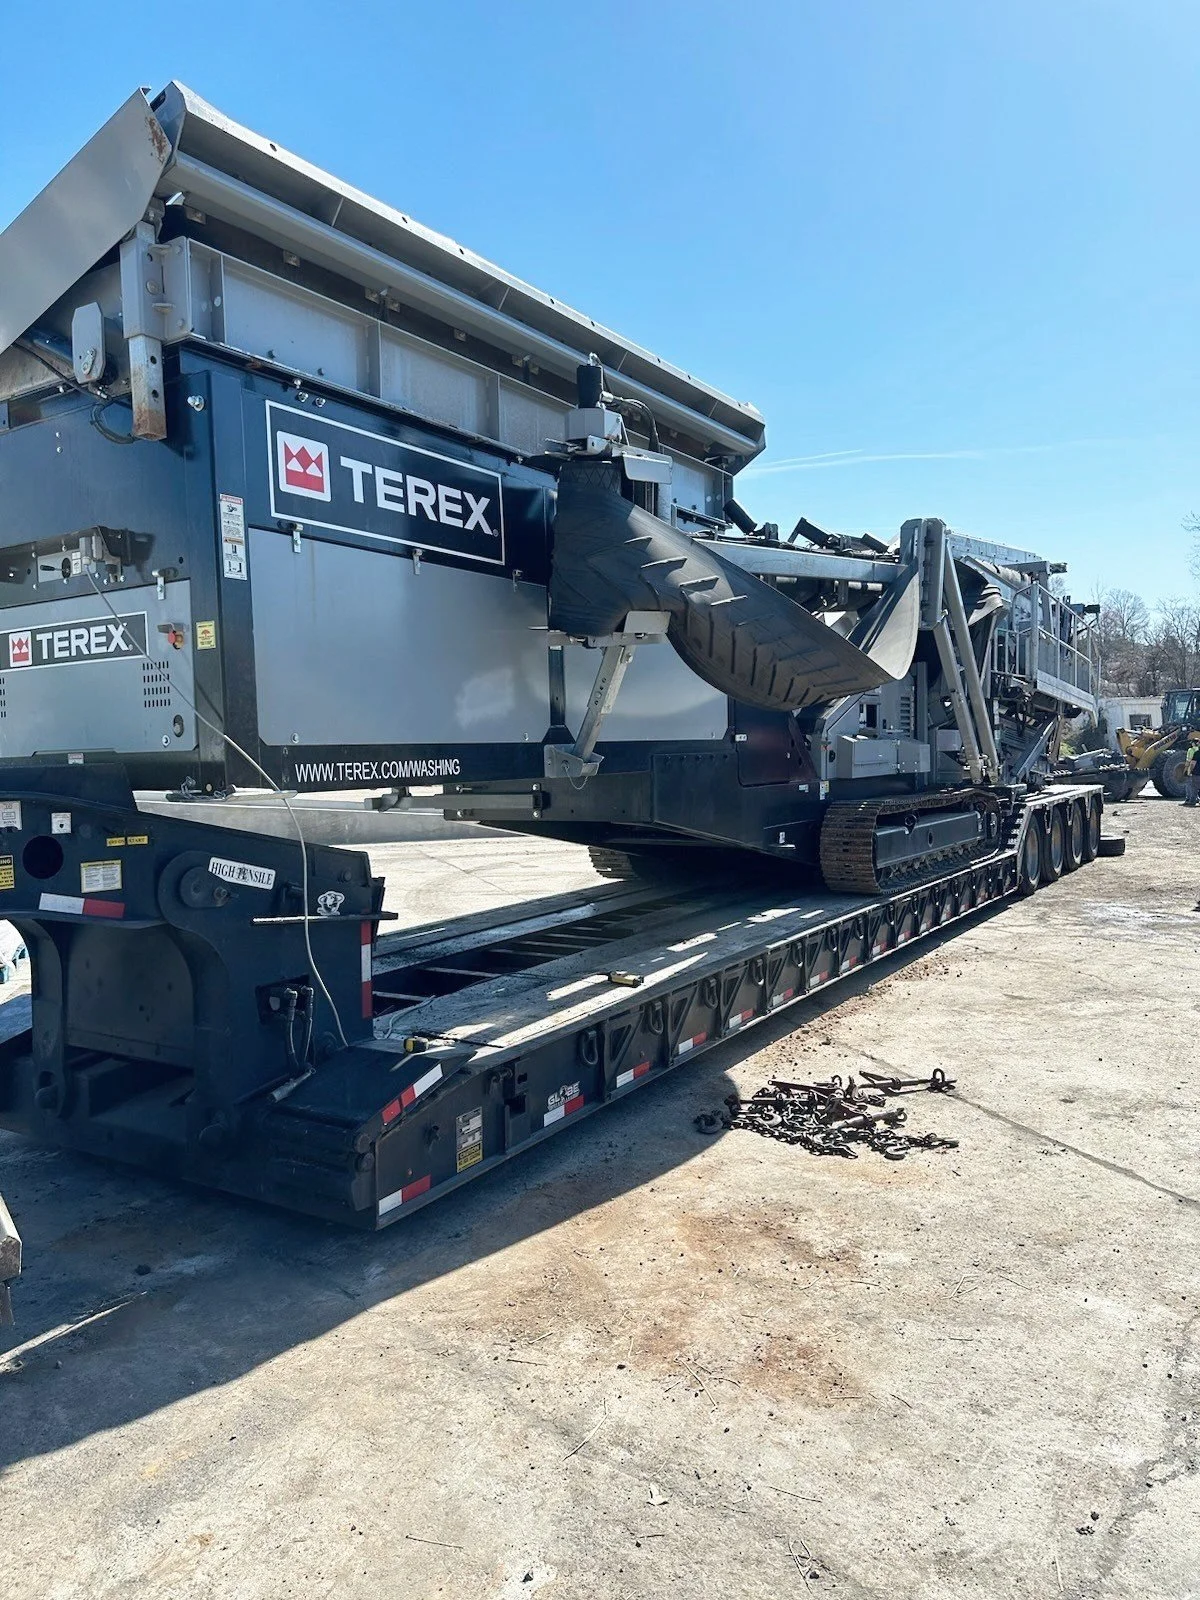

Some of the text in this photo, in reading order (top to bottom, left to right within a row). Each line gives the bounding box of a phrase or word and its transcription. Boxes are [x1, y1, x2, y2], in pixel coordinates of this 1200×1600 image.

[340, 455, 493, 536] TEREX
[36, 622, 129, 660] TEREX
[211, 861, 273, 886] HIGH TENSILE
